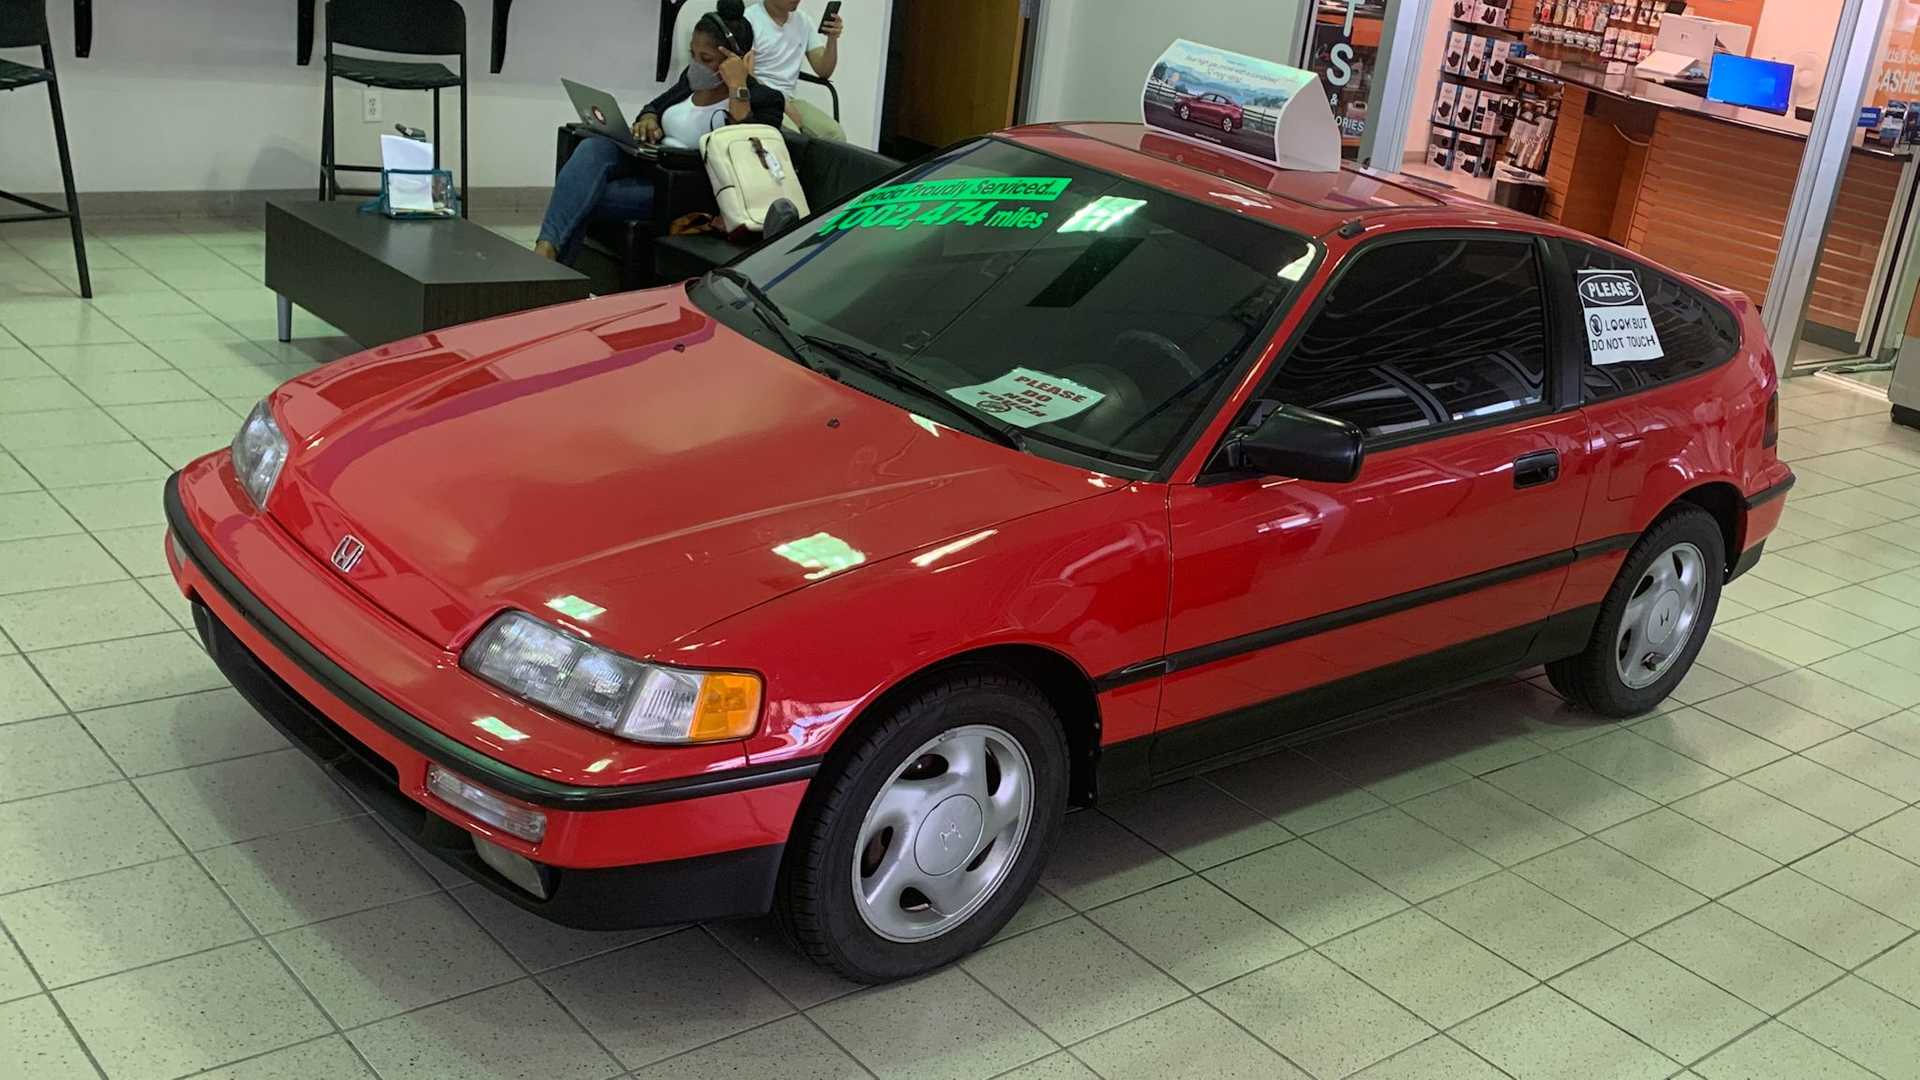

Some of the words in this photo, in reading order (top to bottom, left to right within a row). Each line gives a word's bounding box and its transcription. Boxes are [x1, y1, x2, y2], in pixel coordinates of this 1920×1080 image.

[1330, 93, 1339, 106] &
[983, 206, 1049, 229] miles
[1586, 281, 1634, 298] PLEASE
[1604, 319, 1633, 332] LOOK
[1633, 318, 1648, 329] BUT
[1591, 339, 1605, 352] DO
[1606, 337, 1625, 350] NOT
[1626, 334, 1656, 348] TOUCH
[1013, 375, 1088, 403] PLEASE
[1020, 389, 1053, 402] DO
[1002, 392, 1048, 408] NOT
